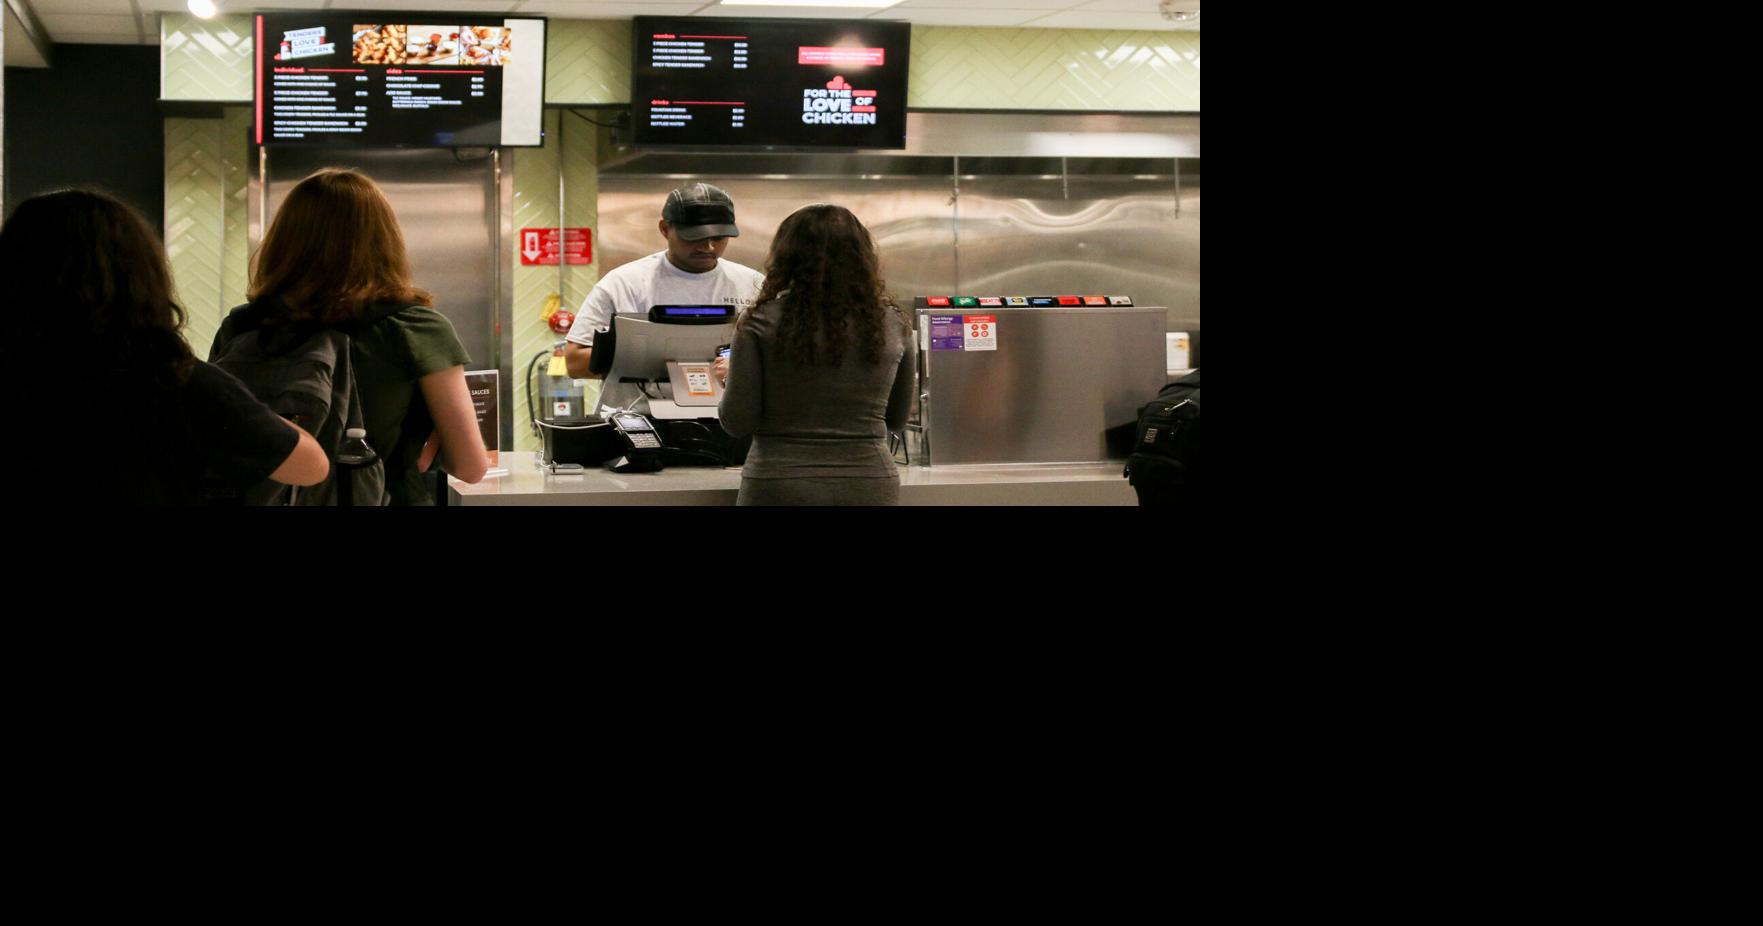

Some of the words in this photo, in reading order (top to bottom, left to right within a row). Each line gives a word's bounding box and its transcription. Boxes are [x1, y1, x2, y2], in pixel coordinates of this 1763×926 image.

[294, 47, 329, 55] CHICKEN
[804, 89, 827, 98] FOR
[828, 90, 852, 98] THE
[804, 98, 852, 112] LOVE
[855, 97, 873, 105] OF
[802, 112, 876, 124] CHICKEN
